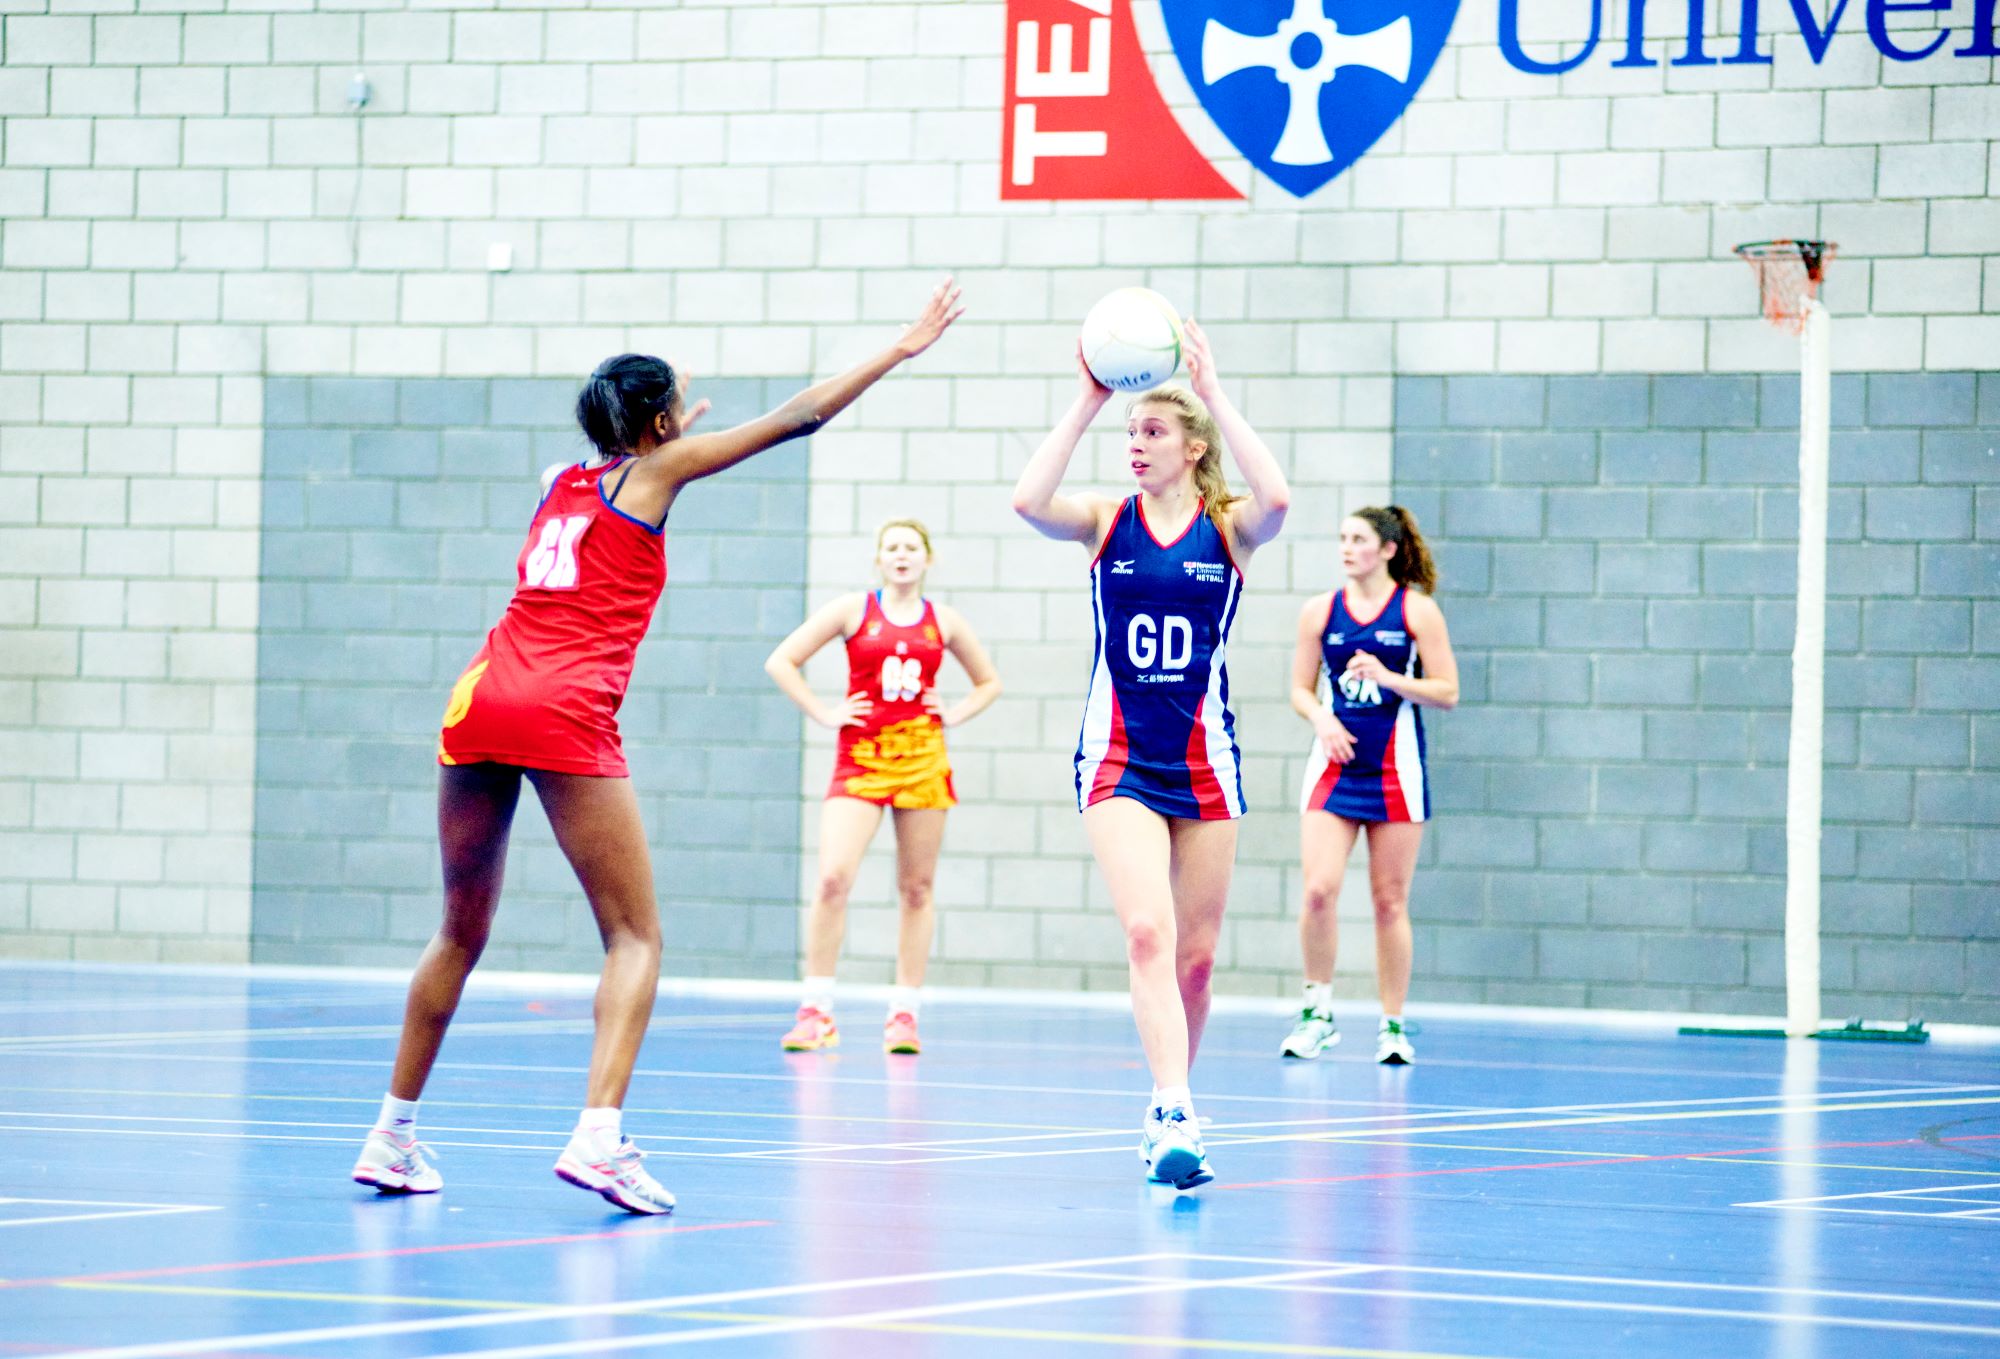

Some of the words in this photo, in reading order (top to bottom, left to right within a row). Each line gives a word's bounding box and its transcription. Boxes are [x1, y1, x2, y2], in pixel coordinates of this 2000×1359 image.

[1011, 0, 1112, 186] TE
[1196, 575, 1225, 583] NETBALL
[1127, 613, 1193, 670] GD
